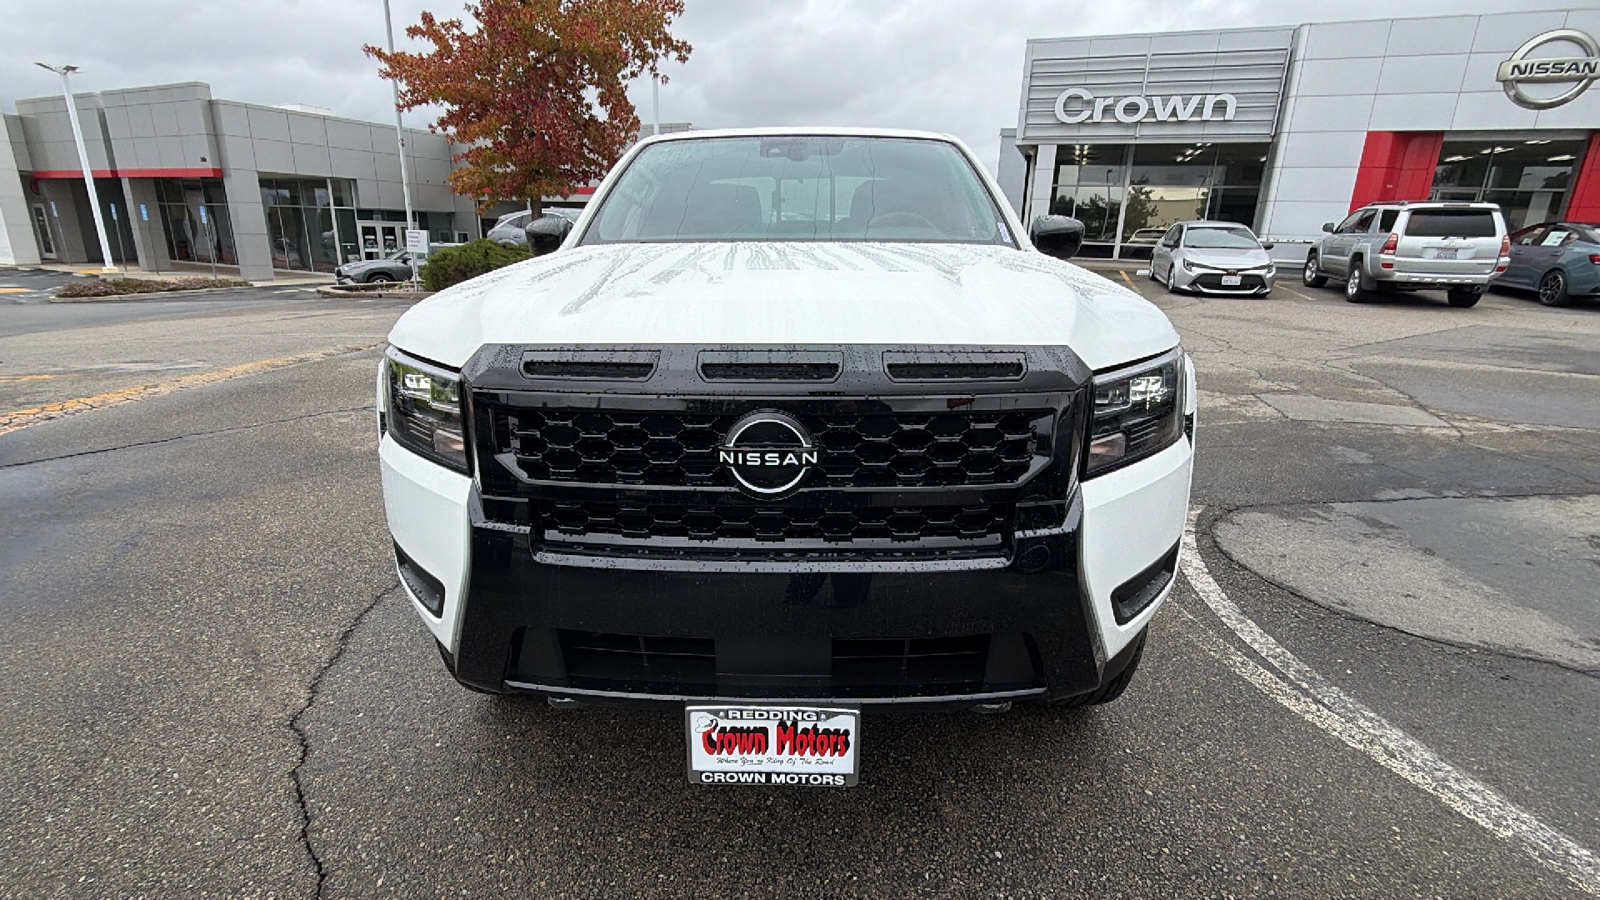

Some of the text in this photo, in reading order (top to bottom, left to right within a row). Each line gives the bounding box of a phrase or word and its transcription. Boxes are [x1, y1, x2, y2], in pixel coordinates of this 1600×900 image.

[1510, 61, 1598, 76] NISSAN
[1054, 87, 1238, 124] Crown
[719, 450, 818, 466] NISSAN
[728, 710, 818, 721] REDDING
[702, 720, 850, 757] Crown Motors
[766, 757, 784, 766] King
[786, 757, 798, 767] Of
[799, 757, 812, 766] The
[815, 758, 835, 766] Road
[701, 772, 846, 786] CROWN MOTORS
